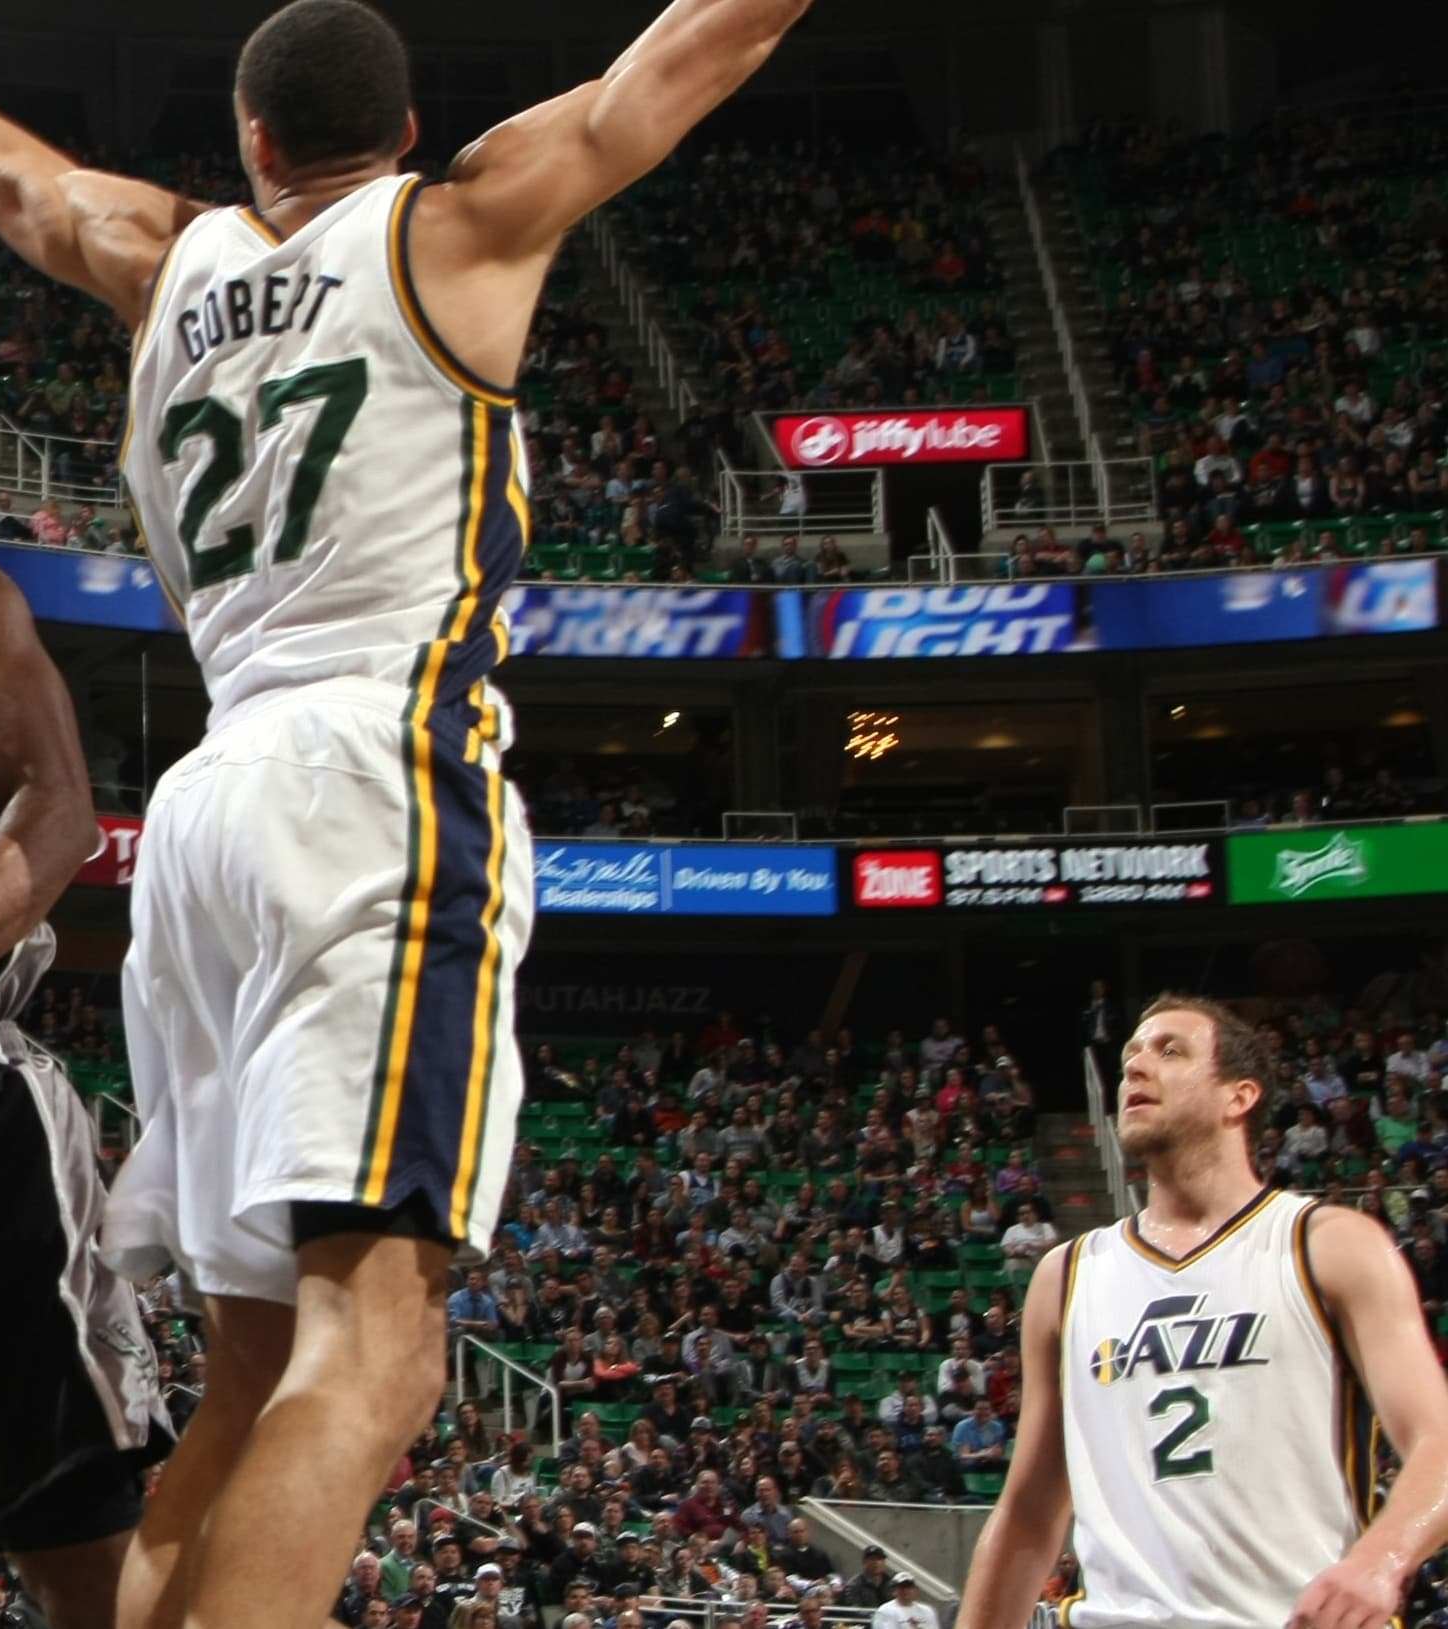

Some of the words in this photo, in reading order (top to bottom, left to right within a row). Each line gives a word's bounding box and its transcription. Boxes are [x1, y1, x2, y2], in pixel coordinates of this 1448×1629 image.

[176, 275, 343, 365] GOBERT
[157, 356, 369, 591] 27
[859, 584, 1054, 619] BUD
[672, 866, 749, 892] Driven
[749, 867, 783, 894] By
[860, 866, 934, 900] ZONE
[944, 850, 1058, 885] SPORTS
[1060, 843, 1210, 882] NETWORK
[1104, 1293, 1271, 1383] JAZZ
[1147, 1384, 1217, 1485] 2
